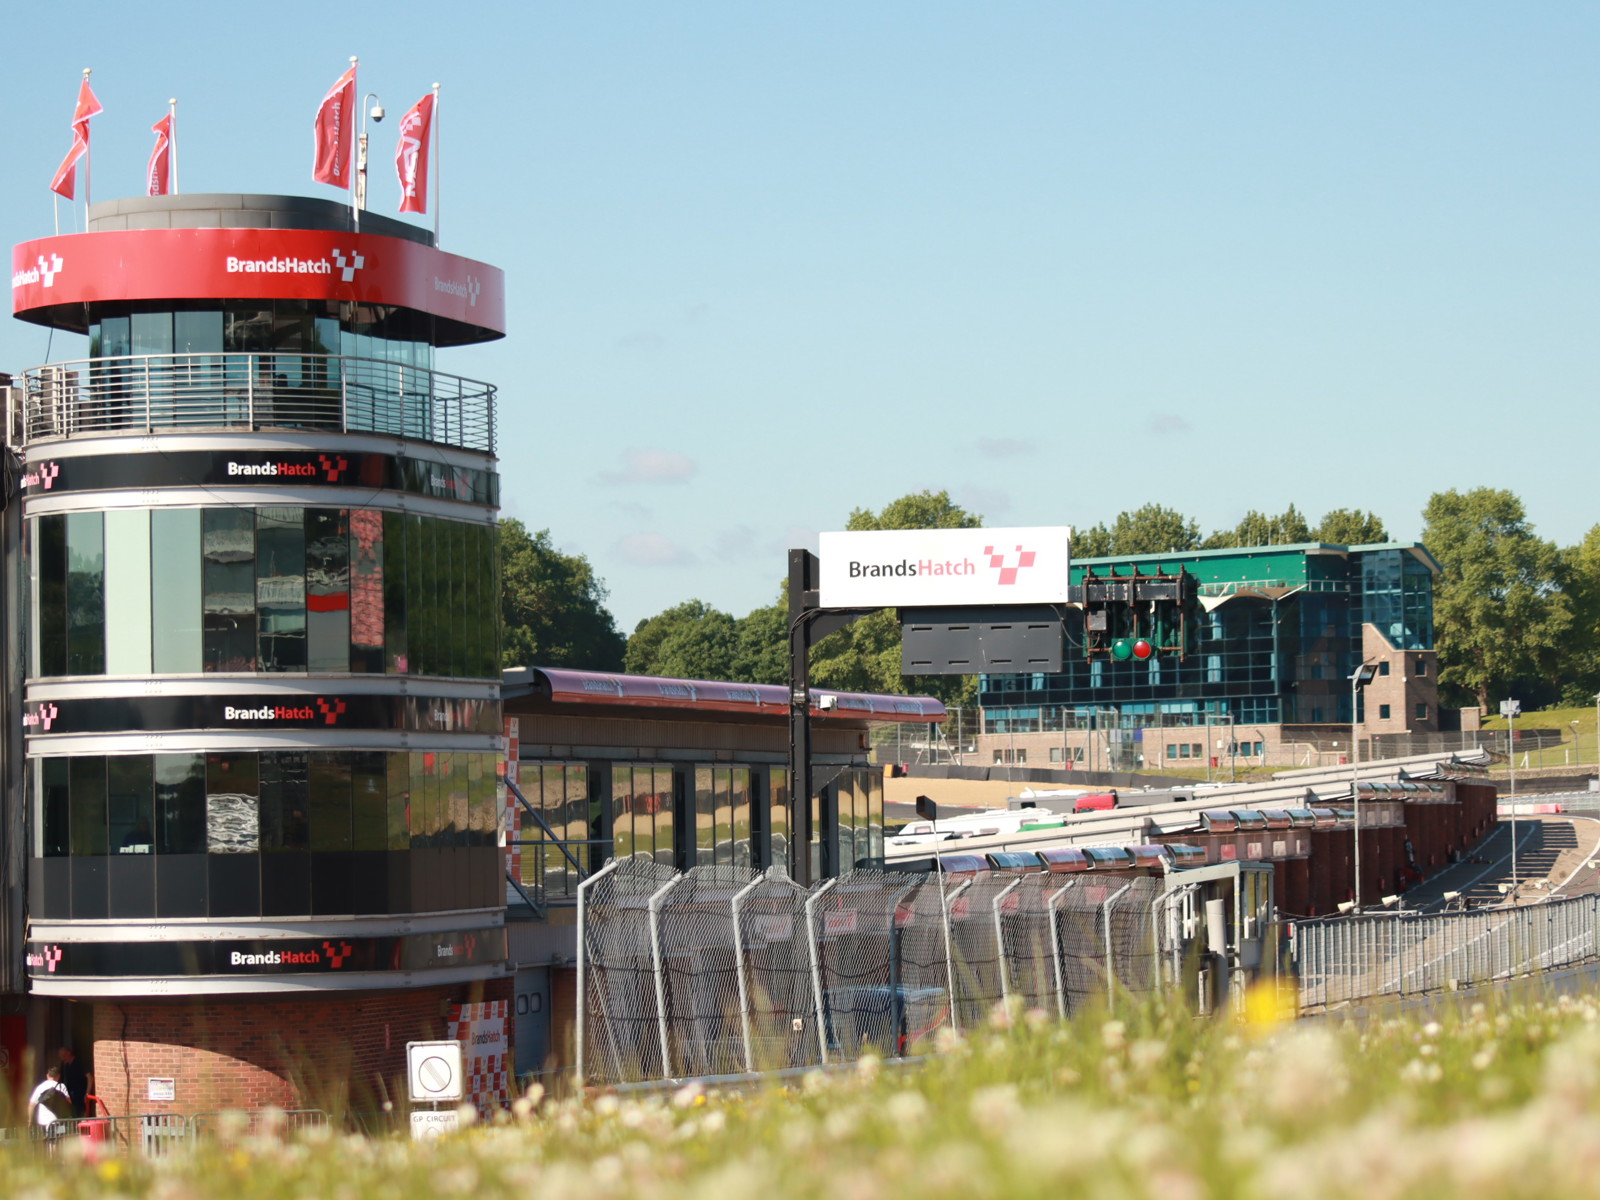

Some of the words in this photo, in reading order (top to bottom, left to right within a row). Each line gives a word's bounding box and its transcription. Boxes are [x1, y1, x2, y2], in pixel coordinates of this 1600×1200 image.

[226, 256, 332, 274] BrandsHatch
[434, 276, 468, 299] BrandsHatch
[227, 461, 316, 476] BrandsHatch
[849, 558, 975, 578] BrandsHatch
[224, 705, 315, 720] BrandsHatch
[230, 950, 320, 966] BrandsHatch
[471, 1028, 501, 1045] BrandsHatch
